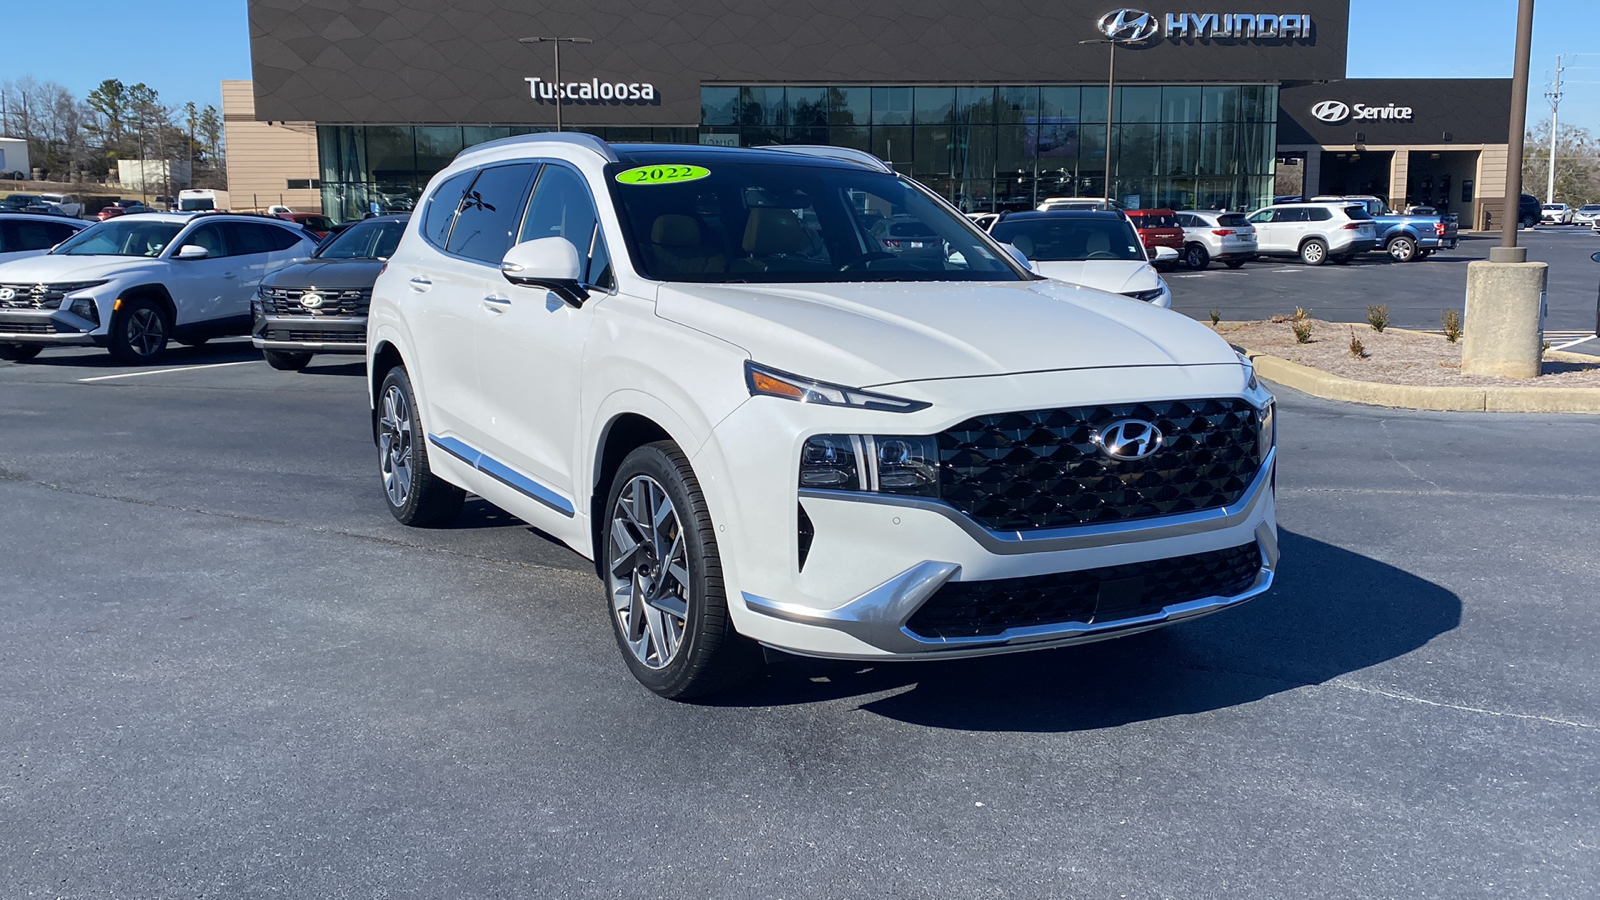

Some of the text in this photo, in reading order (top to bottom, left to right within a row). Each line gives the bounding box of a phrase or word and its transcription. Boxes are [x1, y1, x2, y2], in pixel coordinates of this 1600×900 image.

[1165, 13, 1311, 39] HYUNDAI
[524, 77, 654, 99] Tuscaloosa
[1352, 103, 1412, 119] Service
[635, 167, 693, 182] 2022
